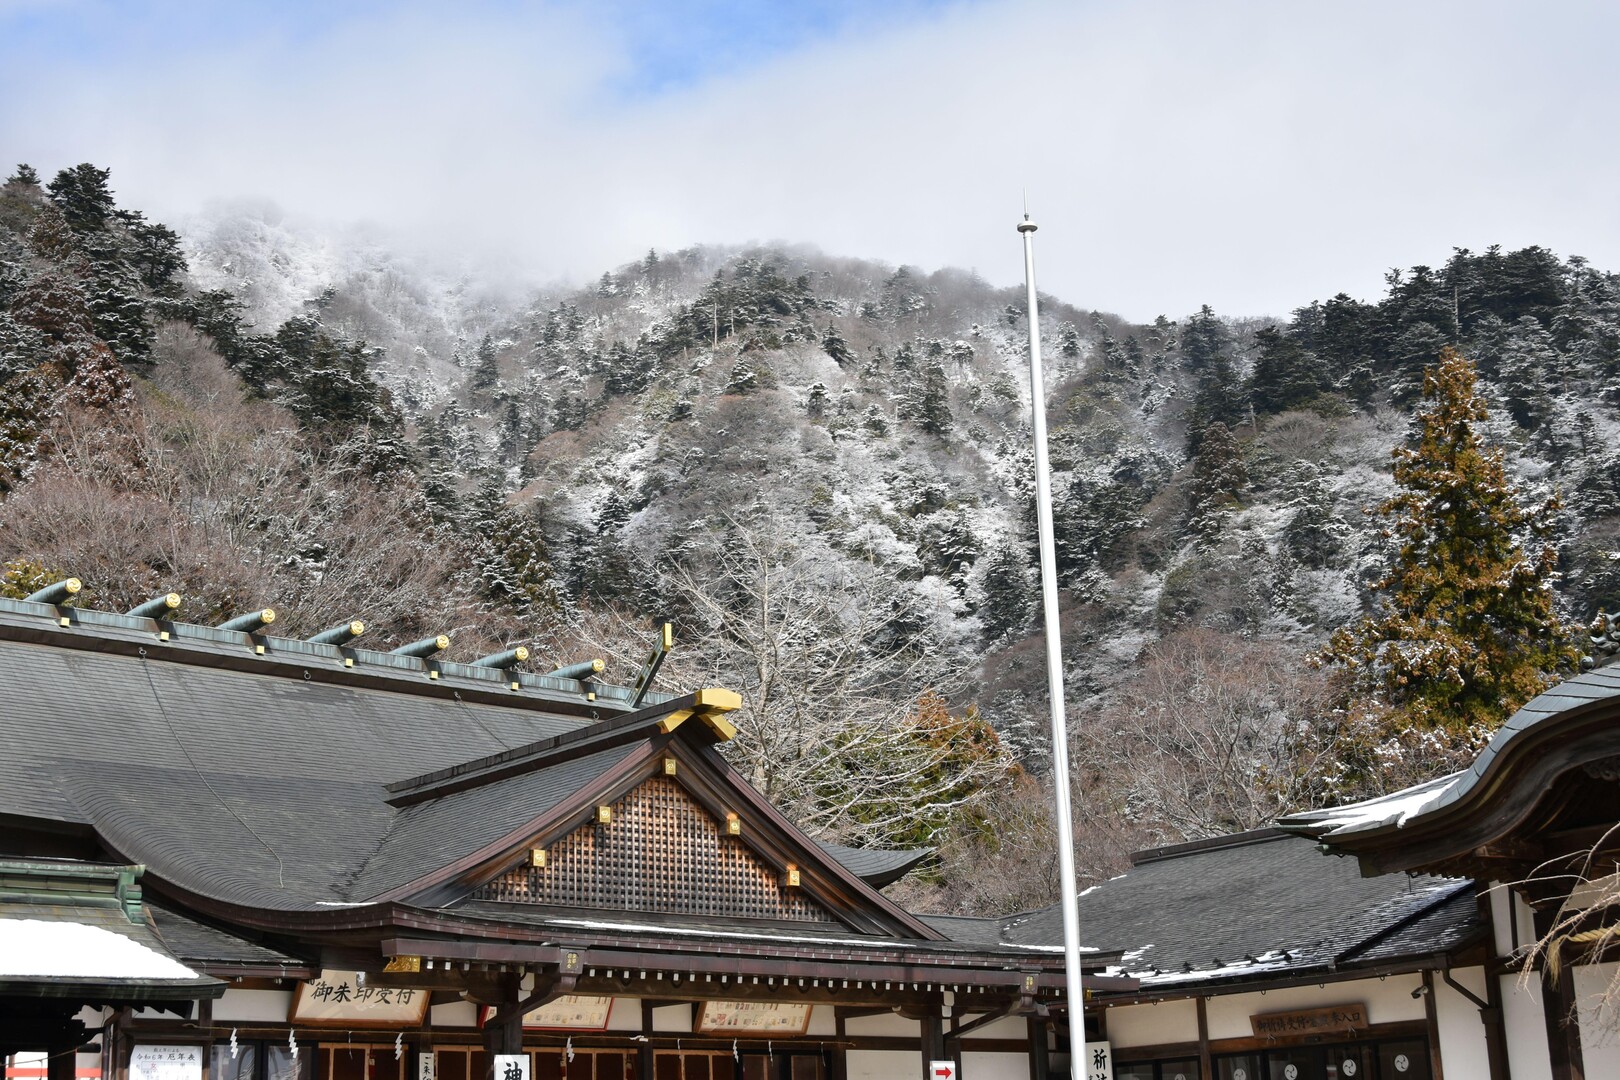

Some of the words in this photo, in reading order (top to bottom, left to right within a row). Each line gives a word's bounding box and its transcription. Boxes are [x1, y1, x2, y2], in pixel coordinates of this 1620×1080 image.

[311, 981, 416, 1004] 御朱印受付
[167, 1053, 195, 1061] 厄年表
[503, 1061, 523, 1080] 神
